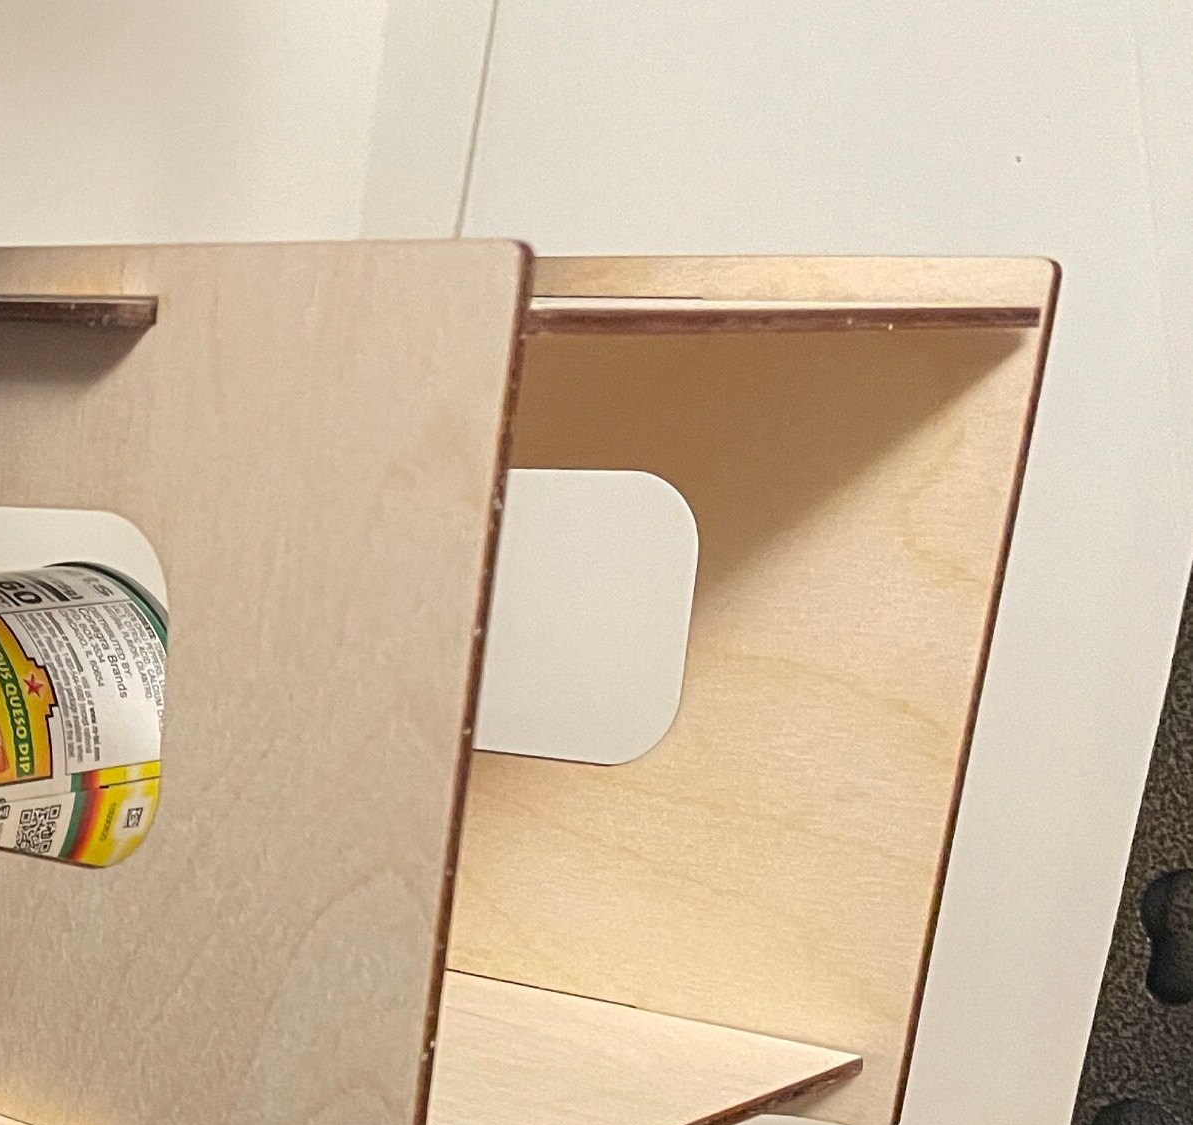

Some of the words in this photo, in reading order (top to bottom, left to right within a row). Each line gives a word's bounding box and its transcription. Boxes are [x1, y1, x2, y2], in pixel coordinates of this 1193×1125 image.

[78, 608, 110, 651] Conagra
[107, 654, 127, 699] Brands
[6, 682, 27, 741] QUESO
[17, 743, 30, 774] DIP
